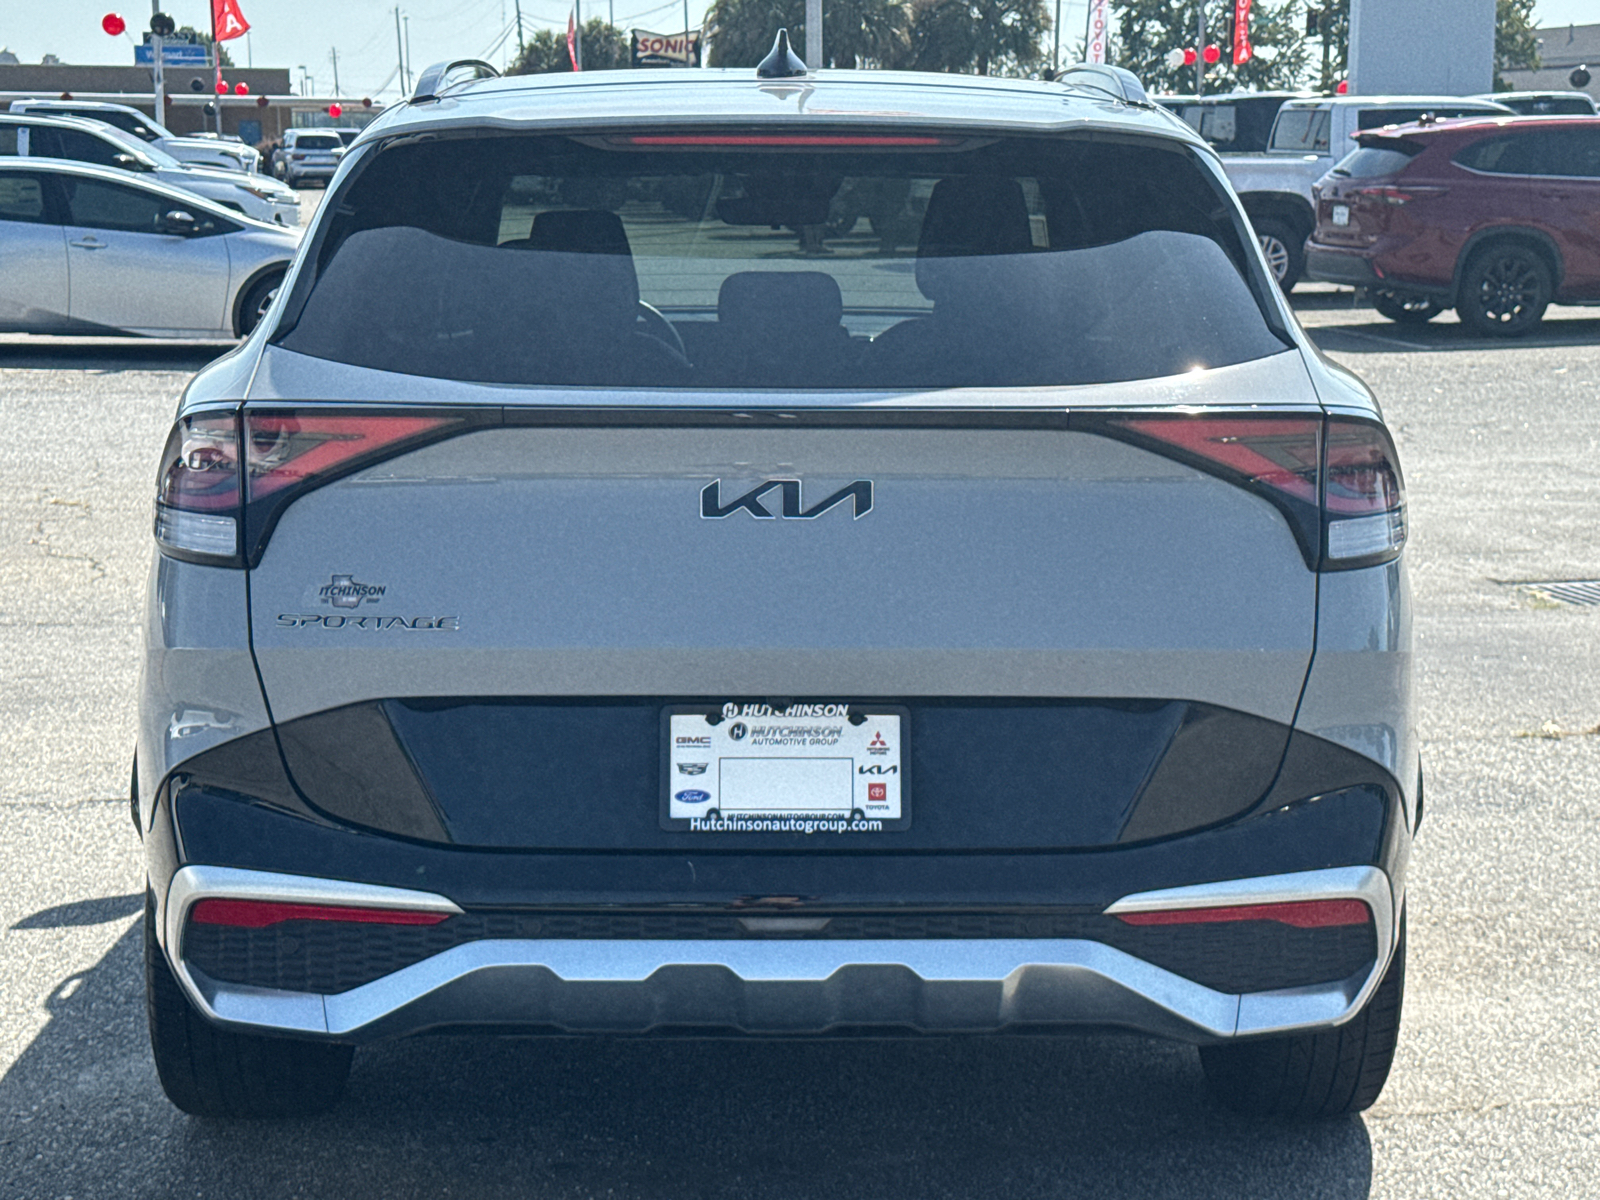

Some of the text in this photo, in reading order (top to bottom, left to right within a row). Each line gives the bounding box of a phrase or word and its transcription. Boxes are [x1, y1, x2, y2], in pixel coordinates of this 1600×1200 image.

[637, 37, 695, 54] SONIC
[145, 50, 183, 59] Wmart
[699, 478, 874, 521] KIA
[276, 613, 460, 631] SPORTAGE
[750, 725, 843, 738] HUTCHINSON
[752, 738, 839, 746] AUTOMOTIVE GROUP
[681, 791, 704, 801] Ford
[690, 817, 883, 834] Hutchinsonautogroup.com
